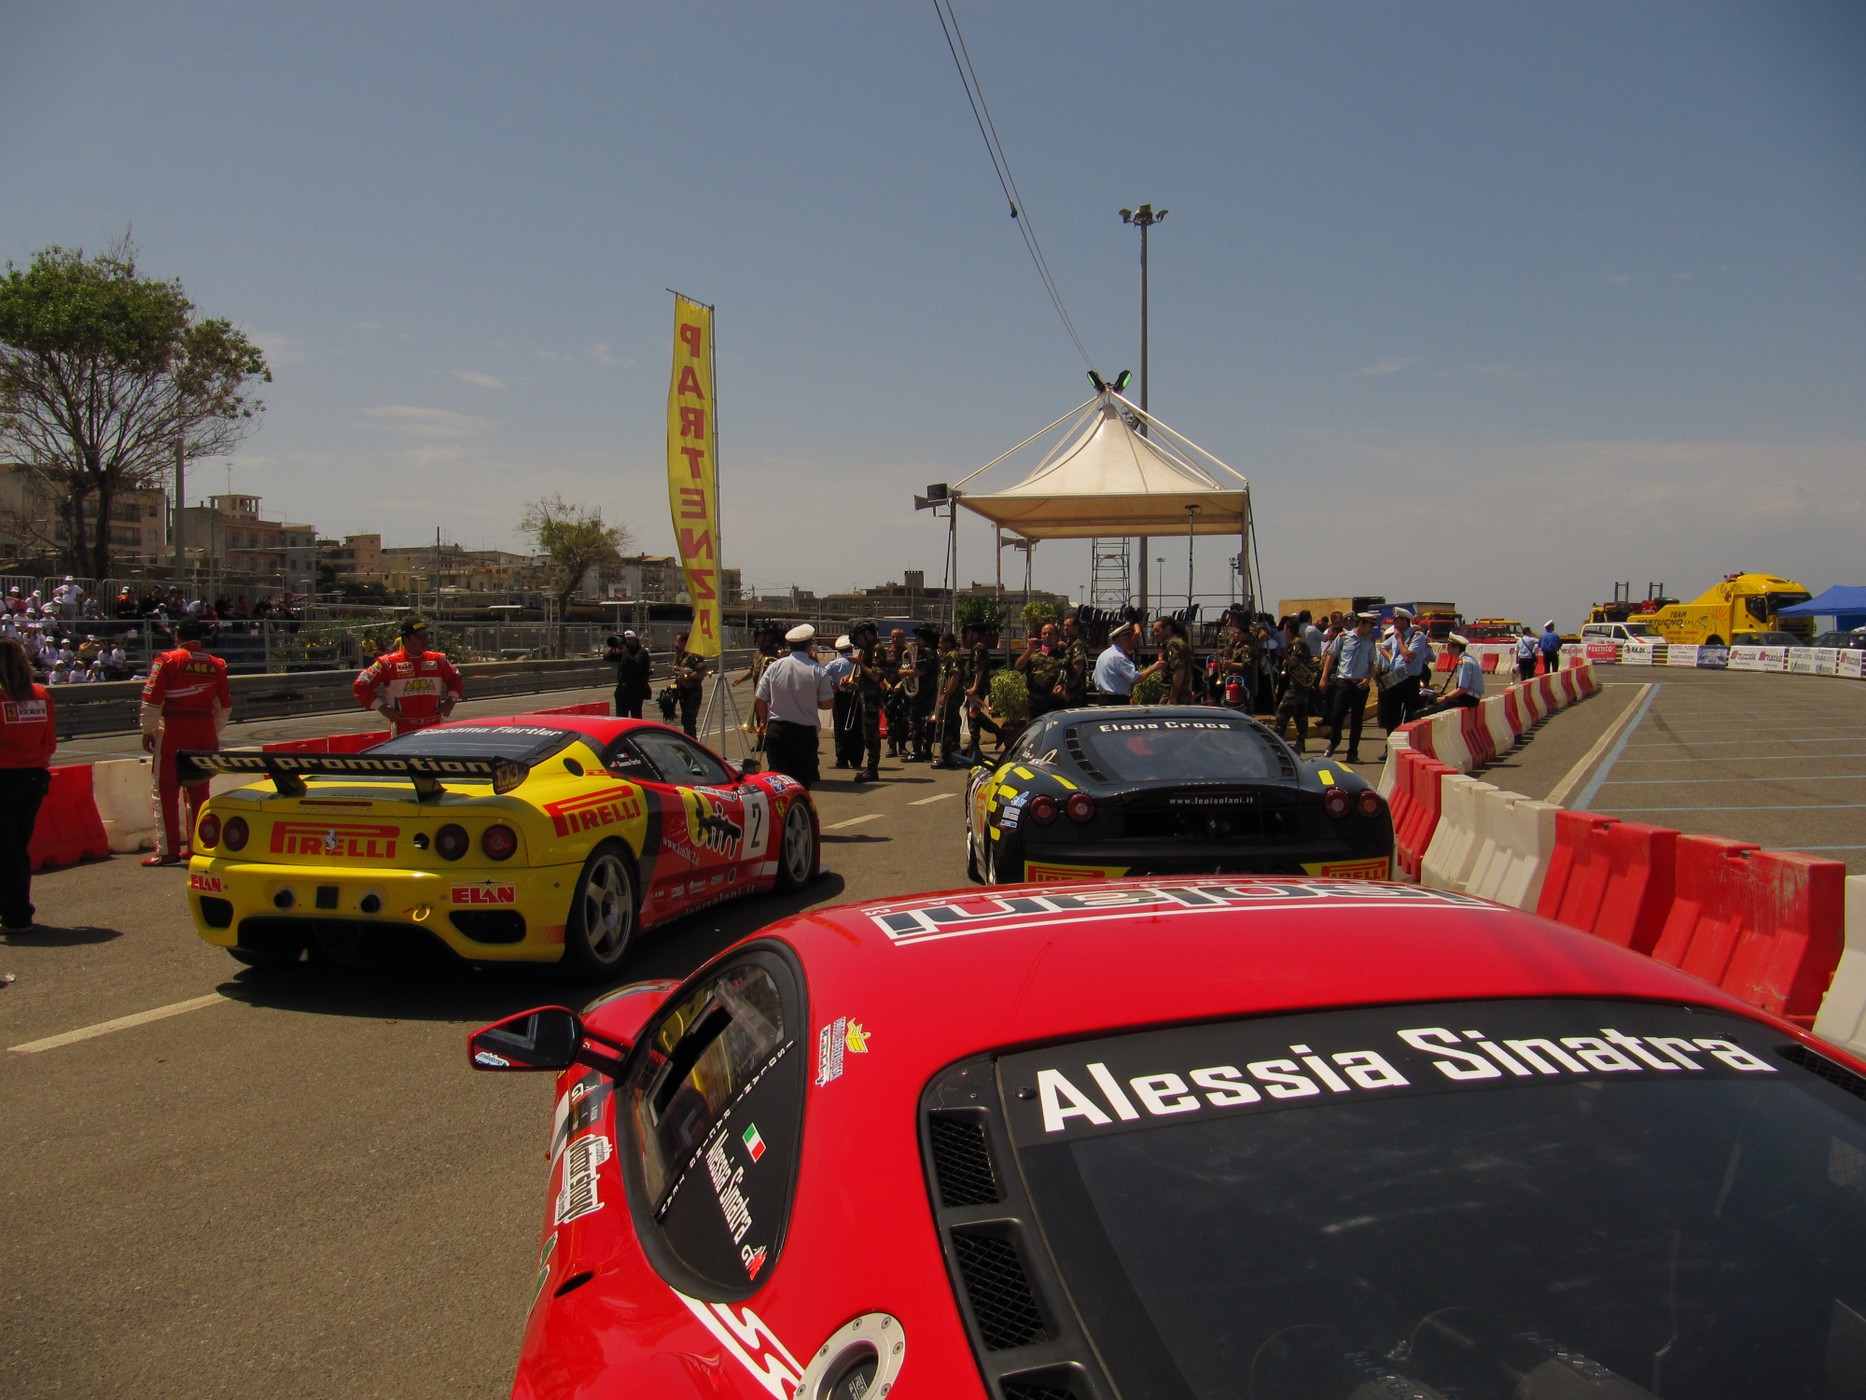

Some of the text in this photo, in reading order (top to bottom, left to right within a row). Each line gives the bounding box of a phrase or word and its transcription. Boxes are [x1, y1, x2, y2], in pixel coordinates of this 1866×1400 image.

[414, 727, 490, 737] Giacomo
[1099, 722, 1159, 733] Elena
[190, 754, 492, 773] gtm promotion
[543, 785, 641, 838] PIRELLI
[751, 803, 762, 848] 2
[269, 821, 400, 859] PIRELLI
[190, 873, 222, 893] ELAN
[451, 886, 515, 904] ELAN
[736, 1040, 794, 1102] ISOLANI
[1036, 1027, 1779, 1132] Alessia Sinatra
[689, 1108, 731, 1168] RACING
[705, 1128, 753, 1245] Alessia Sinatra
